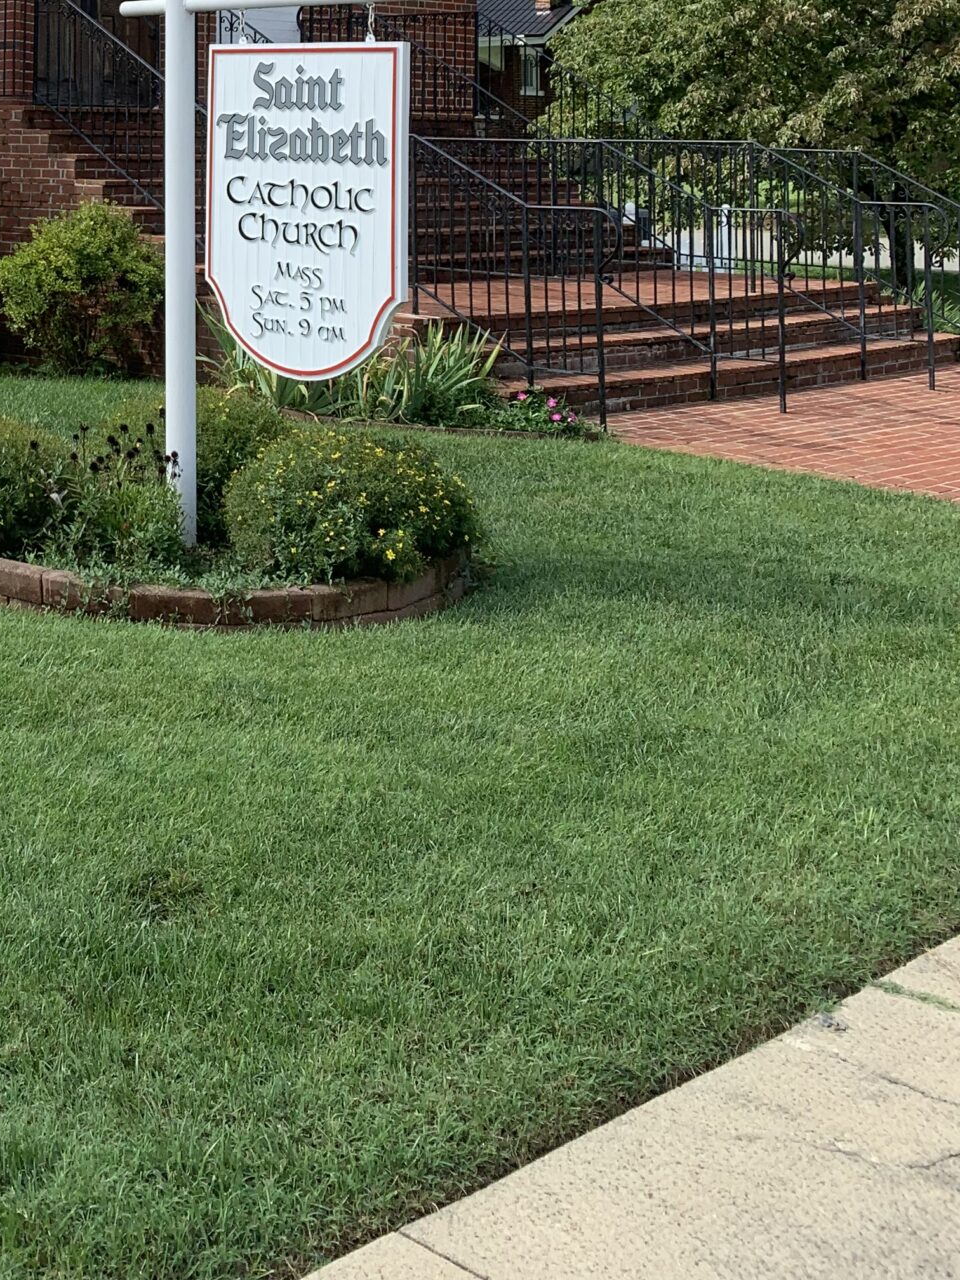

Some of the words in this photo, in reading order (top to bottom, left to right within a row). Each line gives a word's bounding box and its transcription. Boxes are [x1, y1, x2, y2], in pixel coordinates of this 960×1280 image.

[252, 62, 344, 111] Saint
[216, 113, 388, 167] Elizabeth
[300, 291, 314, 311] 5
[298, 318, 311, 337] 9
